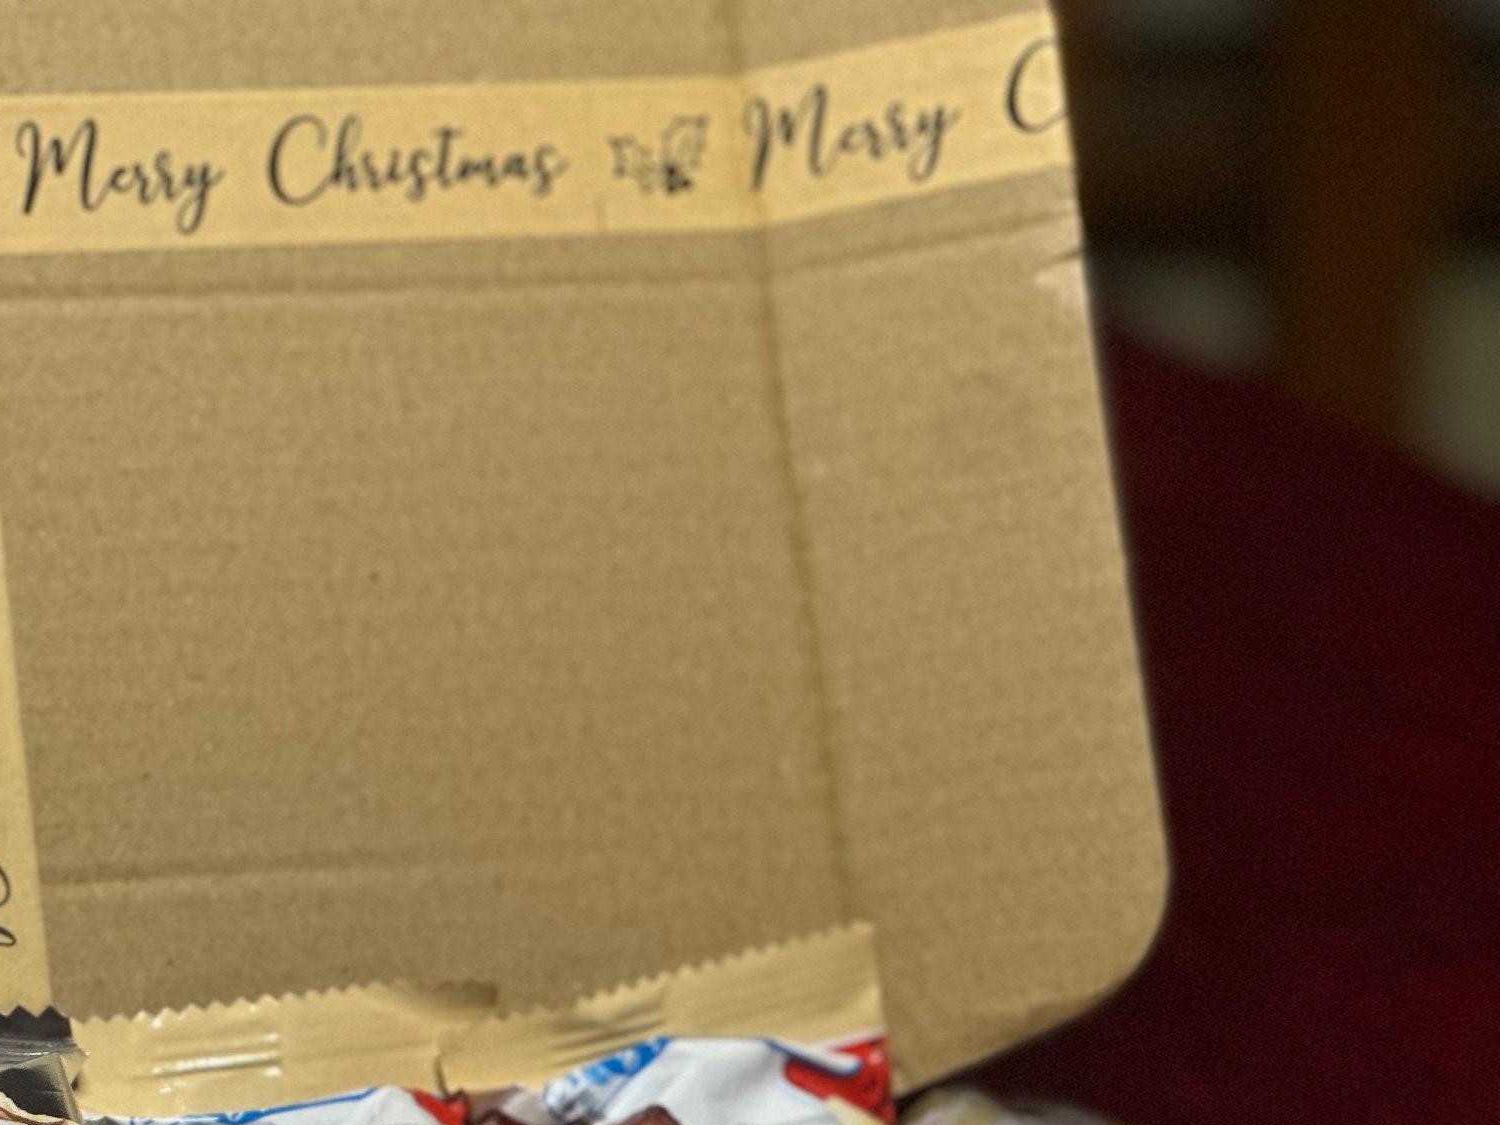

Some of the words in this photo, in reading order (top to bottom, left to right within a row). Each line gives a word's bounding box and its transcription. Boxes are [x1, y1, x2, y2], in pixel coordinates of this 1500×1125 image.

[16, 117, 224, 237] Merry
[267, 111, 569, 206] Christmas
[744, 82, 963, 194] Merry
